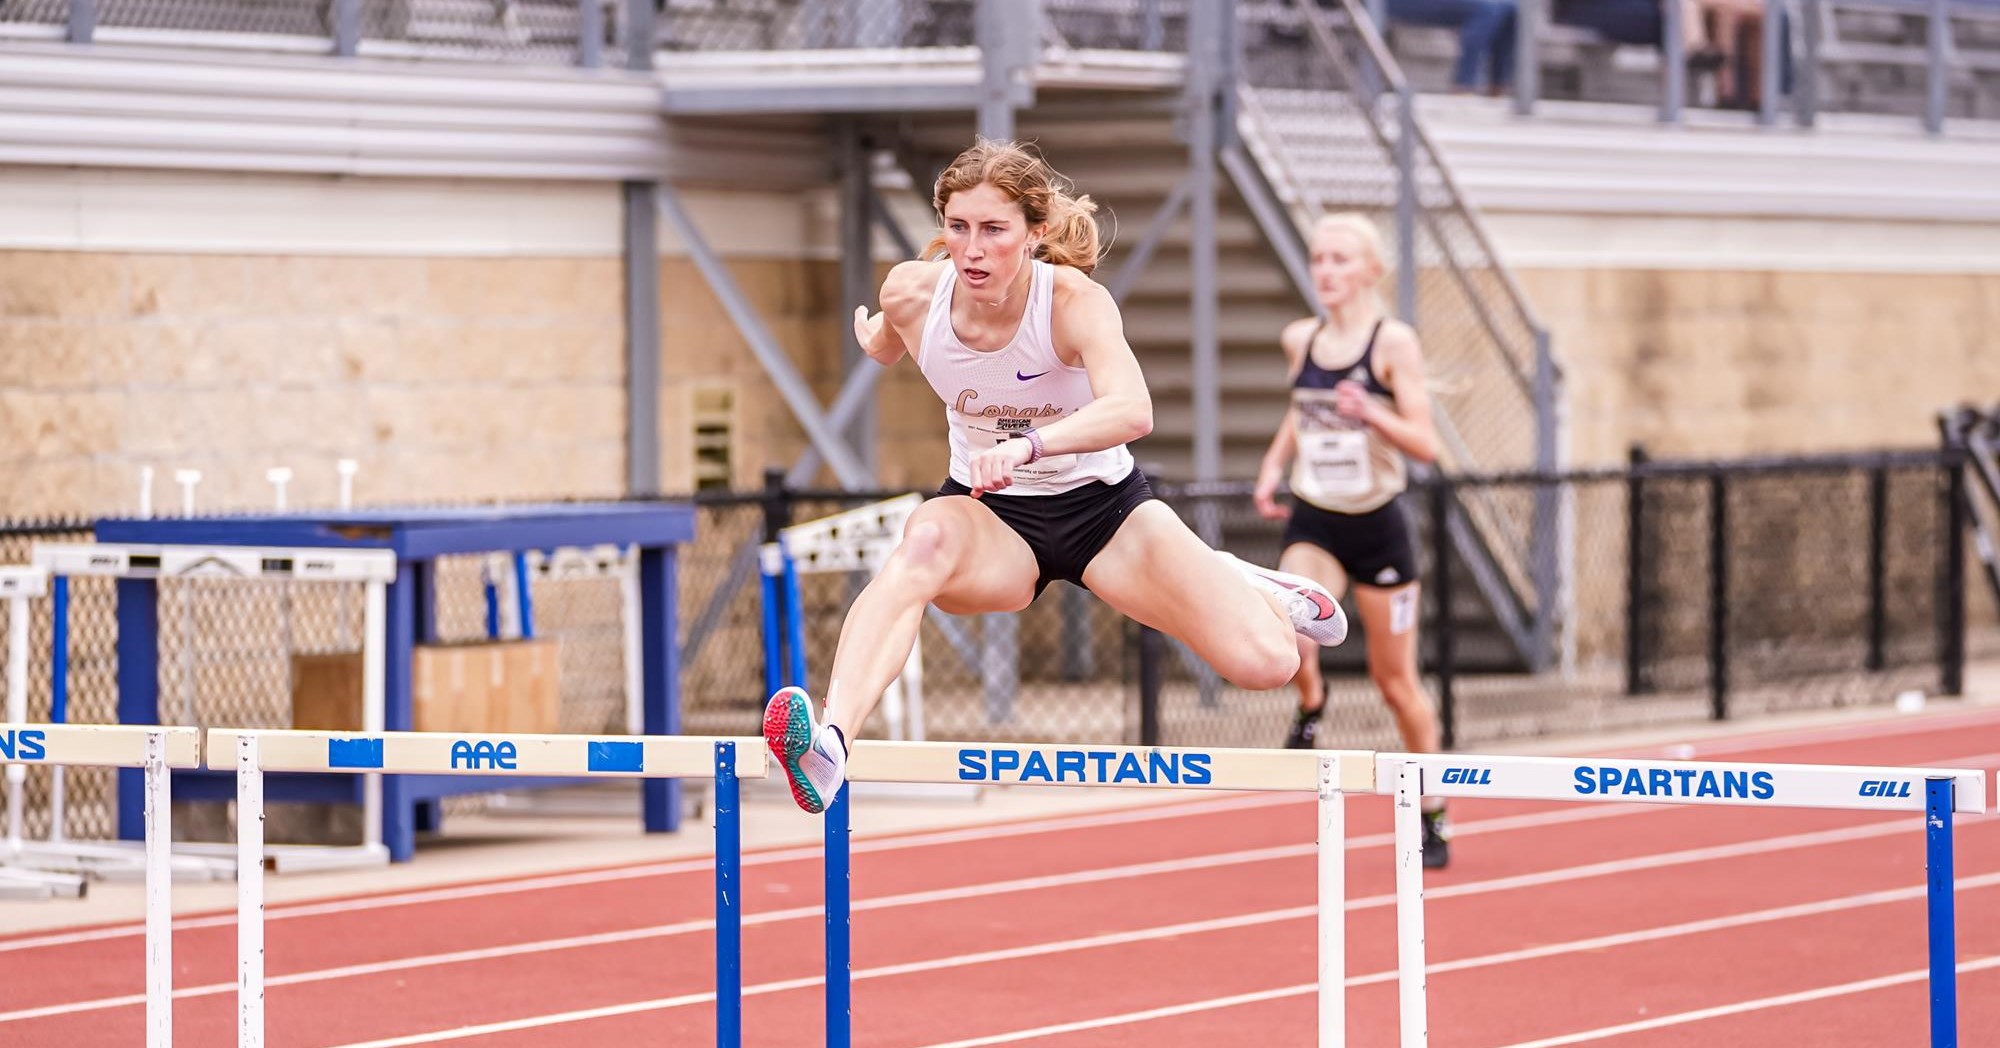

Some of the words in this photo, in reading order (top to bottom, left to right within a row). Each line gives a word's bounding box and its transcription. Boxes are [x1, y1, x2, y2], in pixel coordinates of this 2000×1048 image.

[959, 750, 1211, 785] SPARTANS
[1441, 768, 1492, 785] GILL
[1574, 766, 1775, 800] SPARTANS
[1859, 780, 1912, 798] GILL
